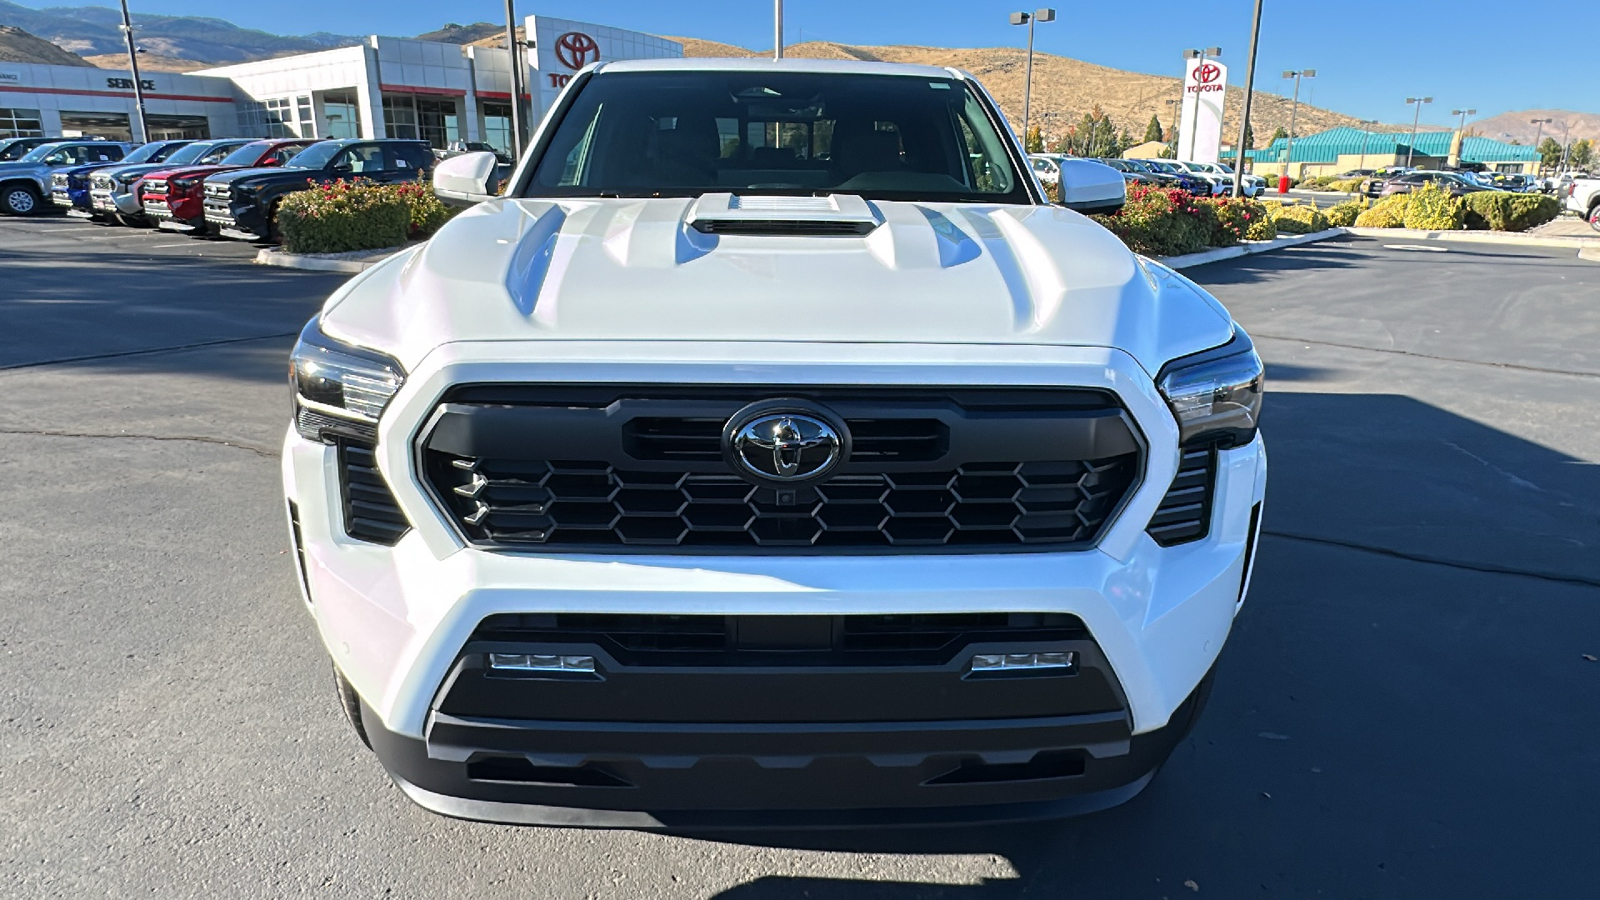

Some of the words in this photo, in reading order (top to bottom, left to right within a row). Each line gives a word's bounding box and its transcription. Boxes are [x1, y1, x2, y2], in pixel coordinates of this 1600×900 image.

[106, 77, 156, 91] SERVCE
[547, 73, 573, 88] TO
[1187, 84, 1224, 93] TOYOTA
